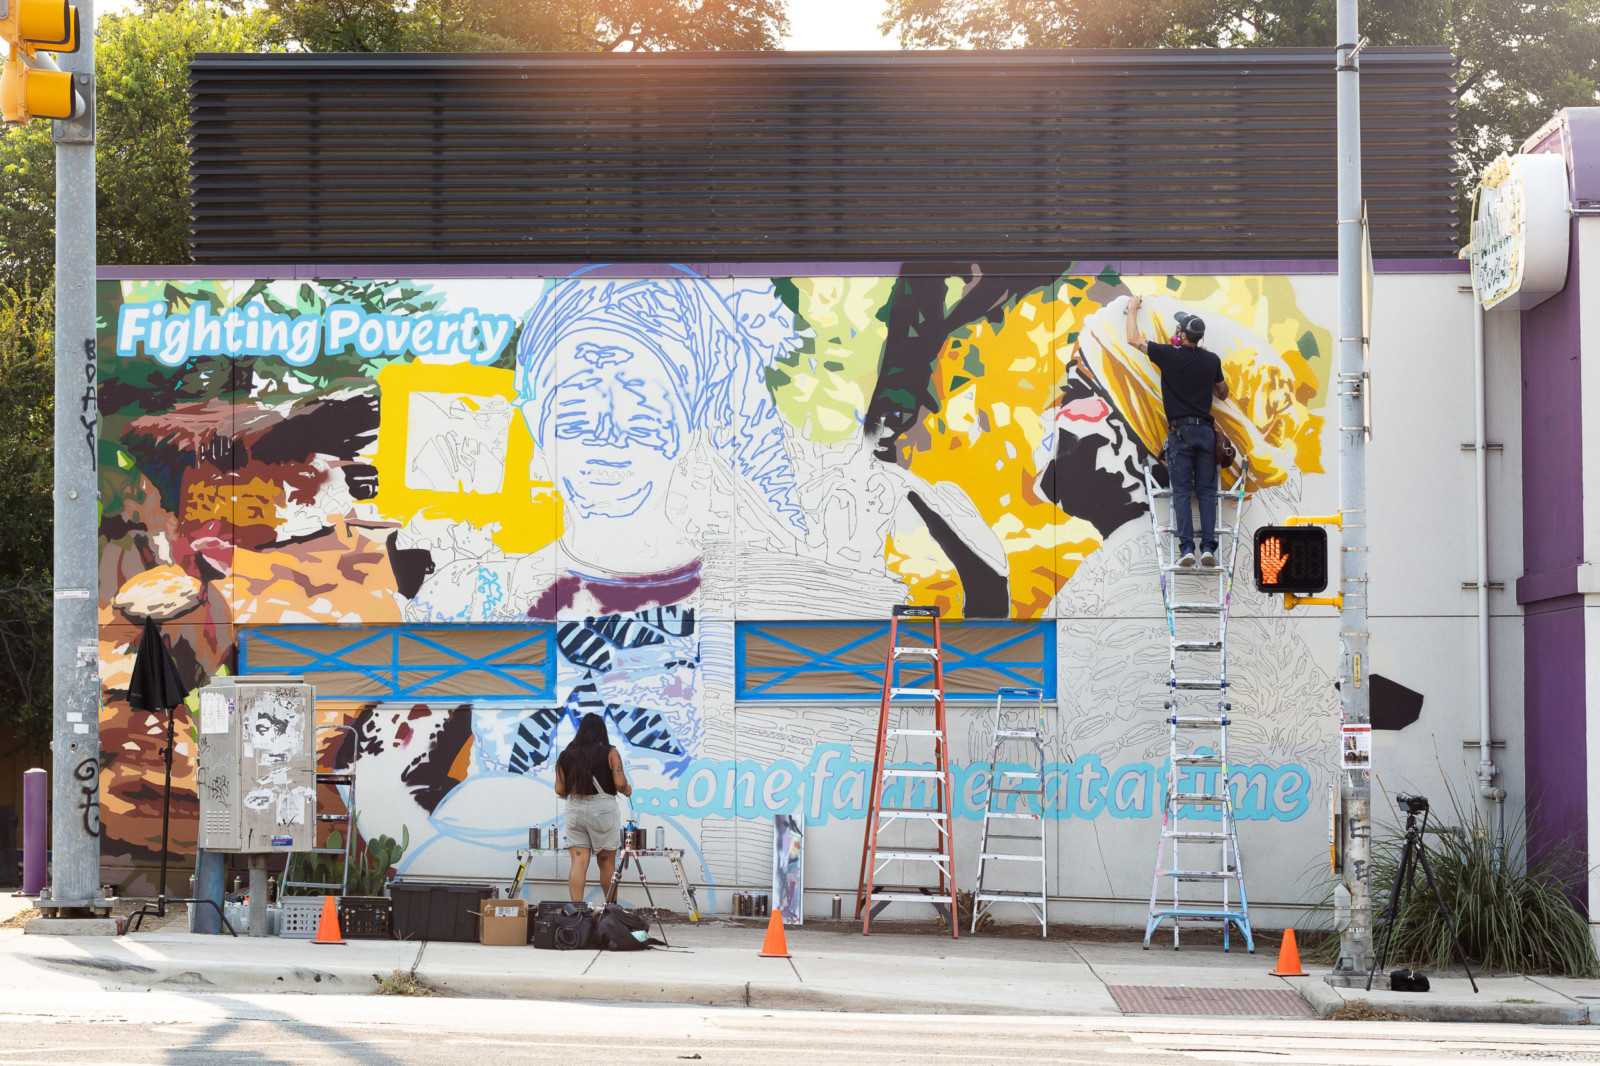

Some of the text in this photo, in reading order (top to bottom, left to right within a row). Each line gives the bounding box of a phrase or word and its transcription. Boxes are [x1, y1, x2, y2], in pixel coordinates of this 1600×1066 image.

[118, 303, 513, 365] Fighting Poverty
[1037, 763, 1103, 812] at
[1114, 770, 1148, 812] a
